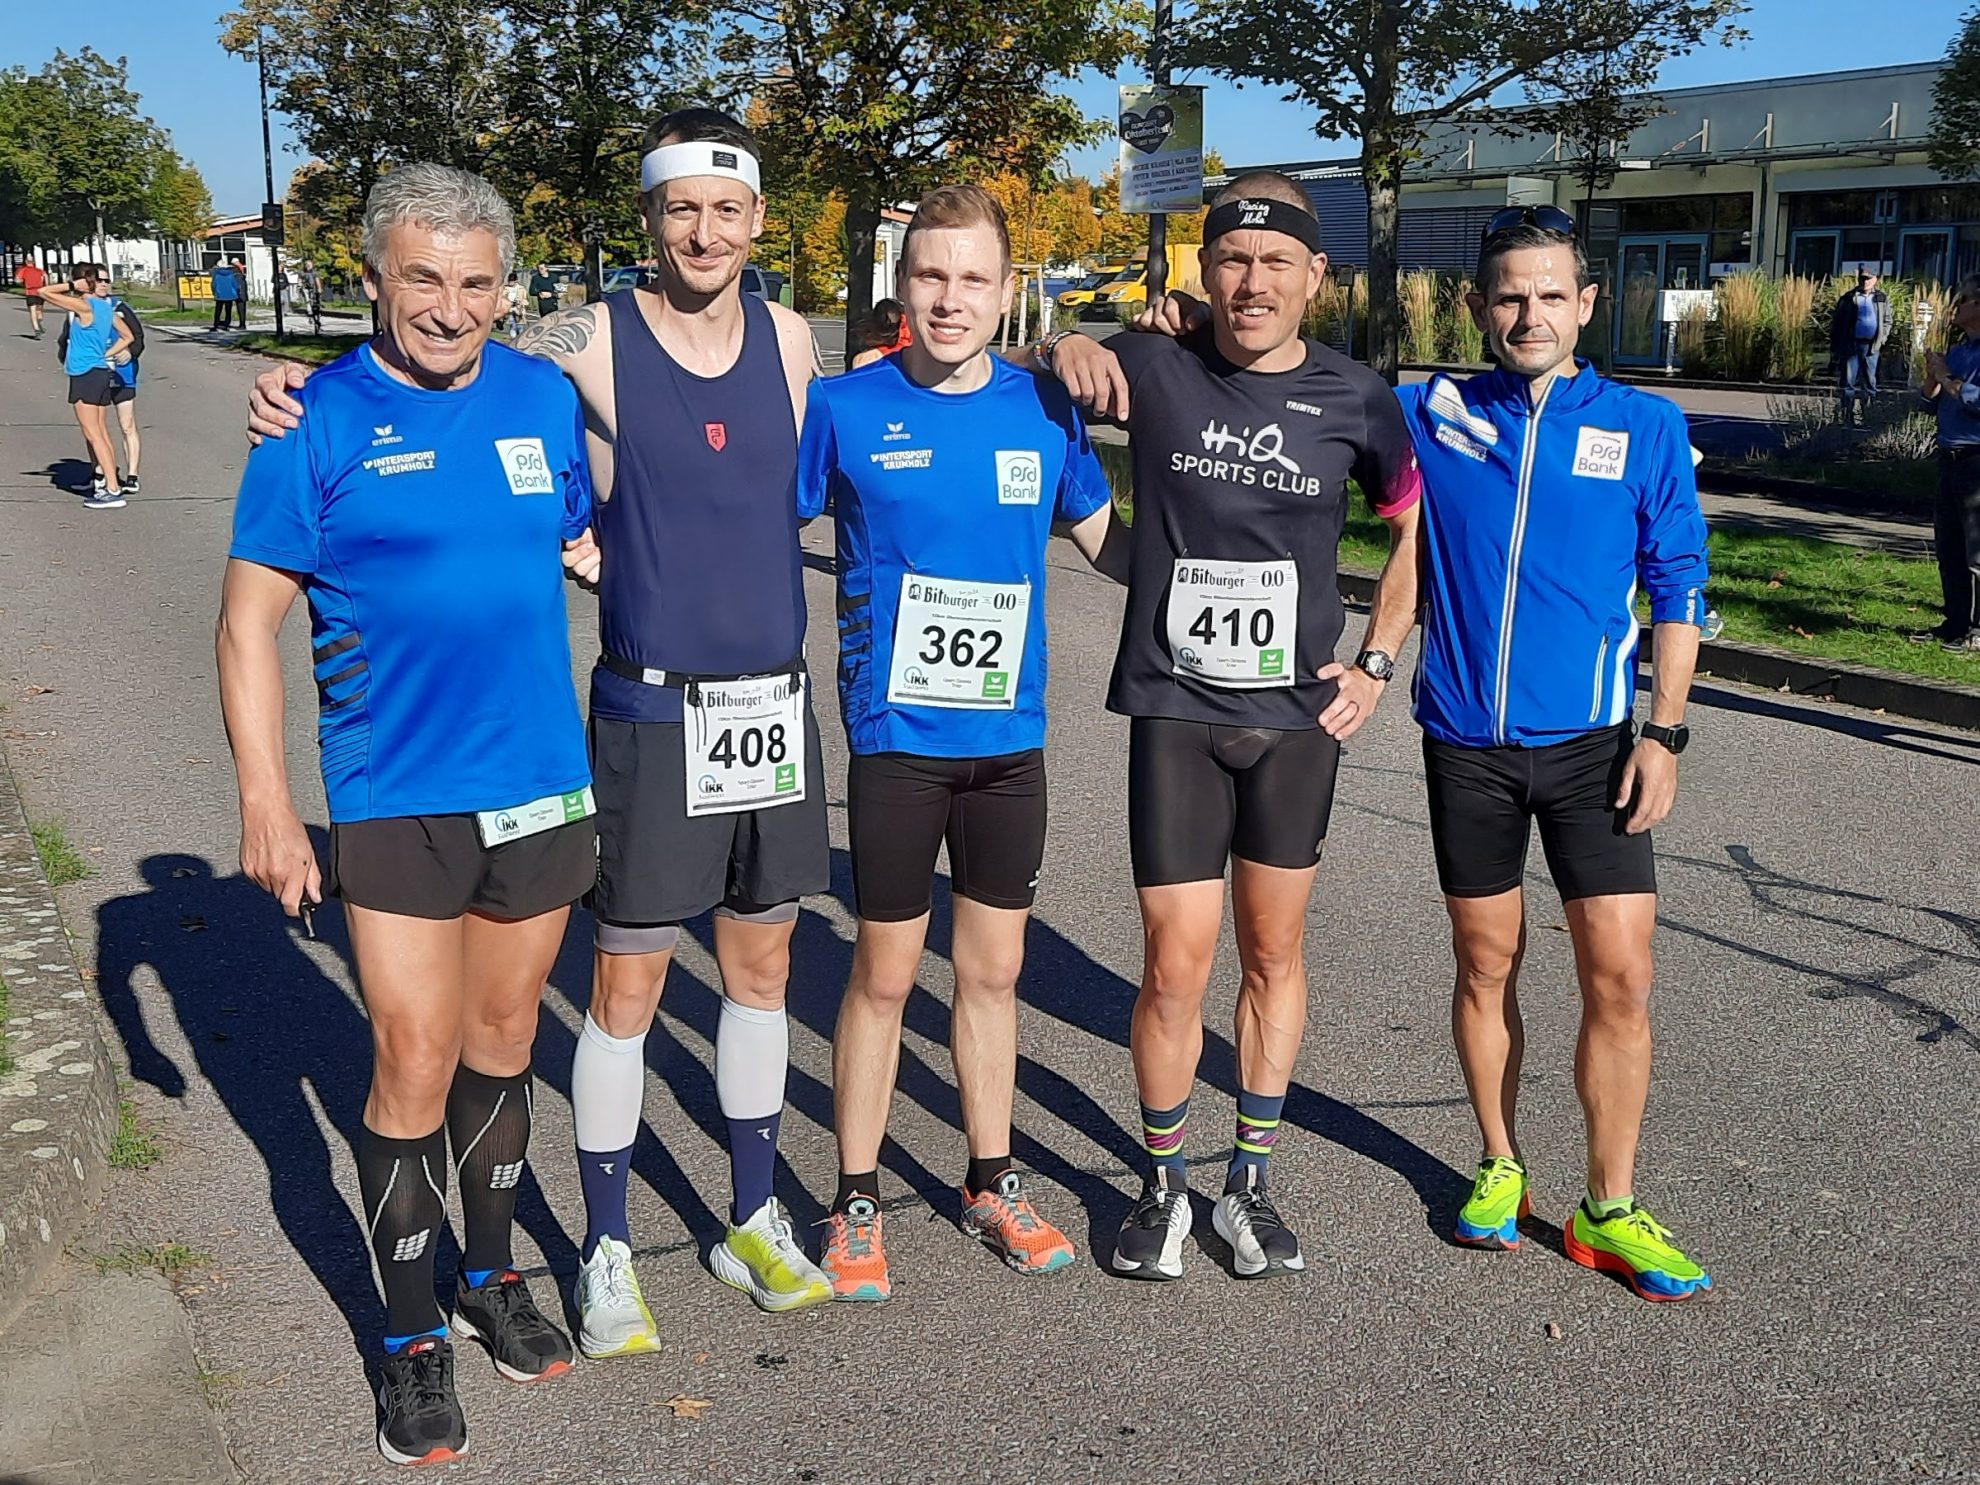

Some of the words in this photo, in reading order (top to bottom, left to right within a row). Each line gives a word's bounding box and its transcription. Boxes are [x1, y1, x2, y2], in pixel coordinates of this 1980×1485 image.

[373, 450, 435, 468] INTERSPORT
[880, 450, 933, 461] INTERSPORT
[379, 461, 434, 476] KRUMHOLZ
[1170, 452, 1256, 485] SPORTS
[1262, 470, 1320, 496] CLUB
[1577, 458, 1618, 475] Bank
[512, 473, 550, 488] Bank
[1003, 484, 1037, 499] Bank
[1190, 568, 1245, 589] Bitburger
[923, 586, 979, 609] Bitburger
[1188, 606, 1274, 647] 410
[919, 625, 1003, 668] 362
[706, 691, 762, 709] Bitburger
[708, 723, 786, 769] 408
